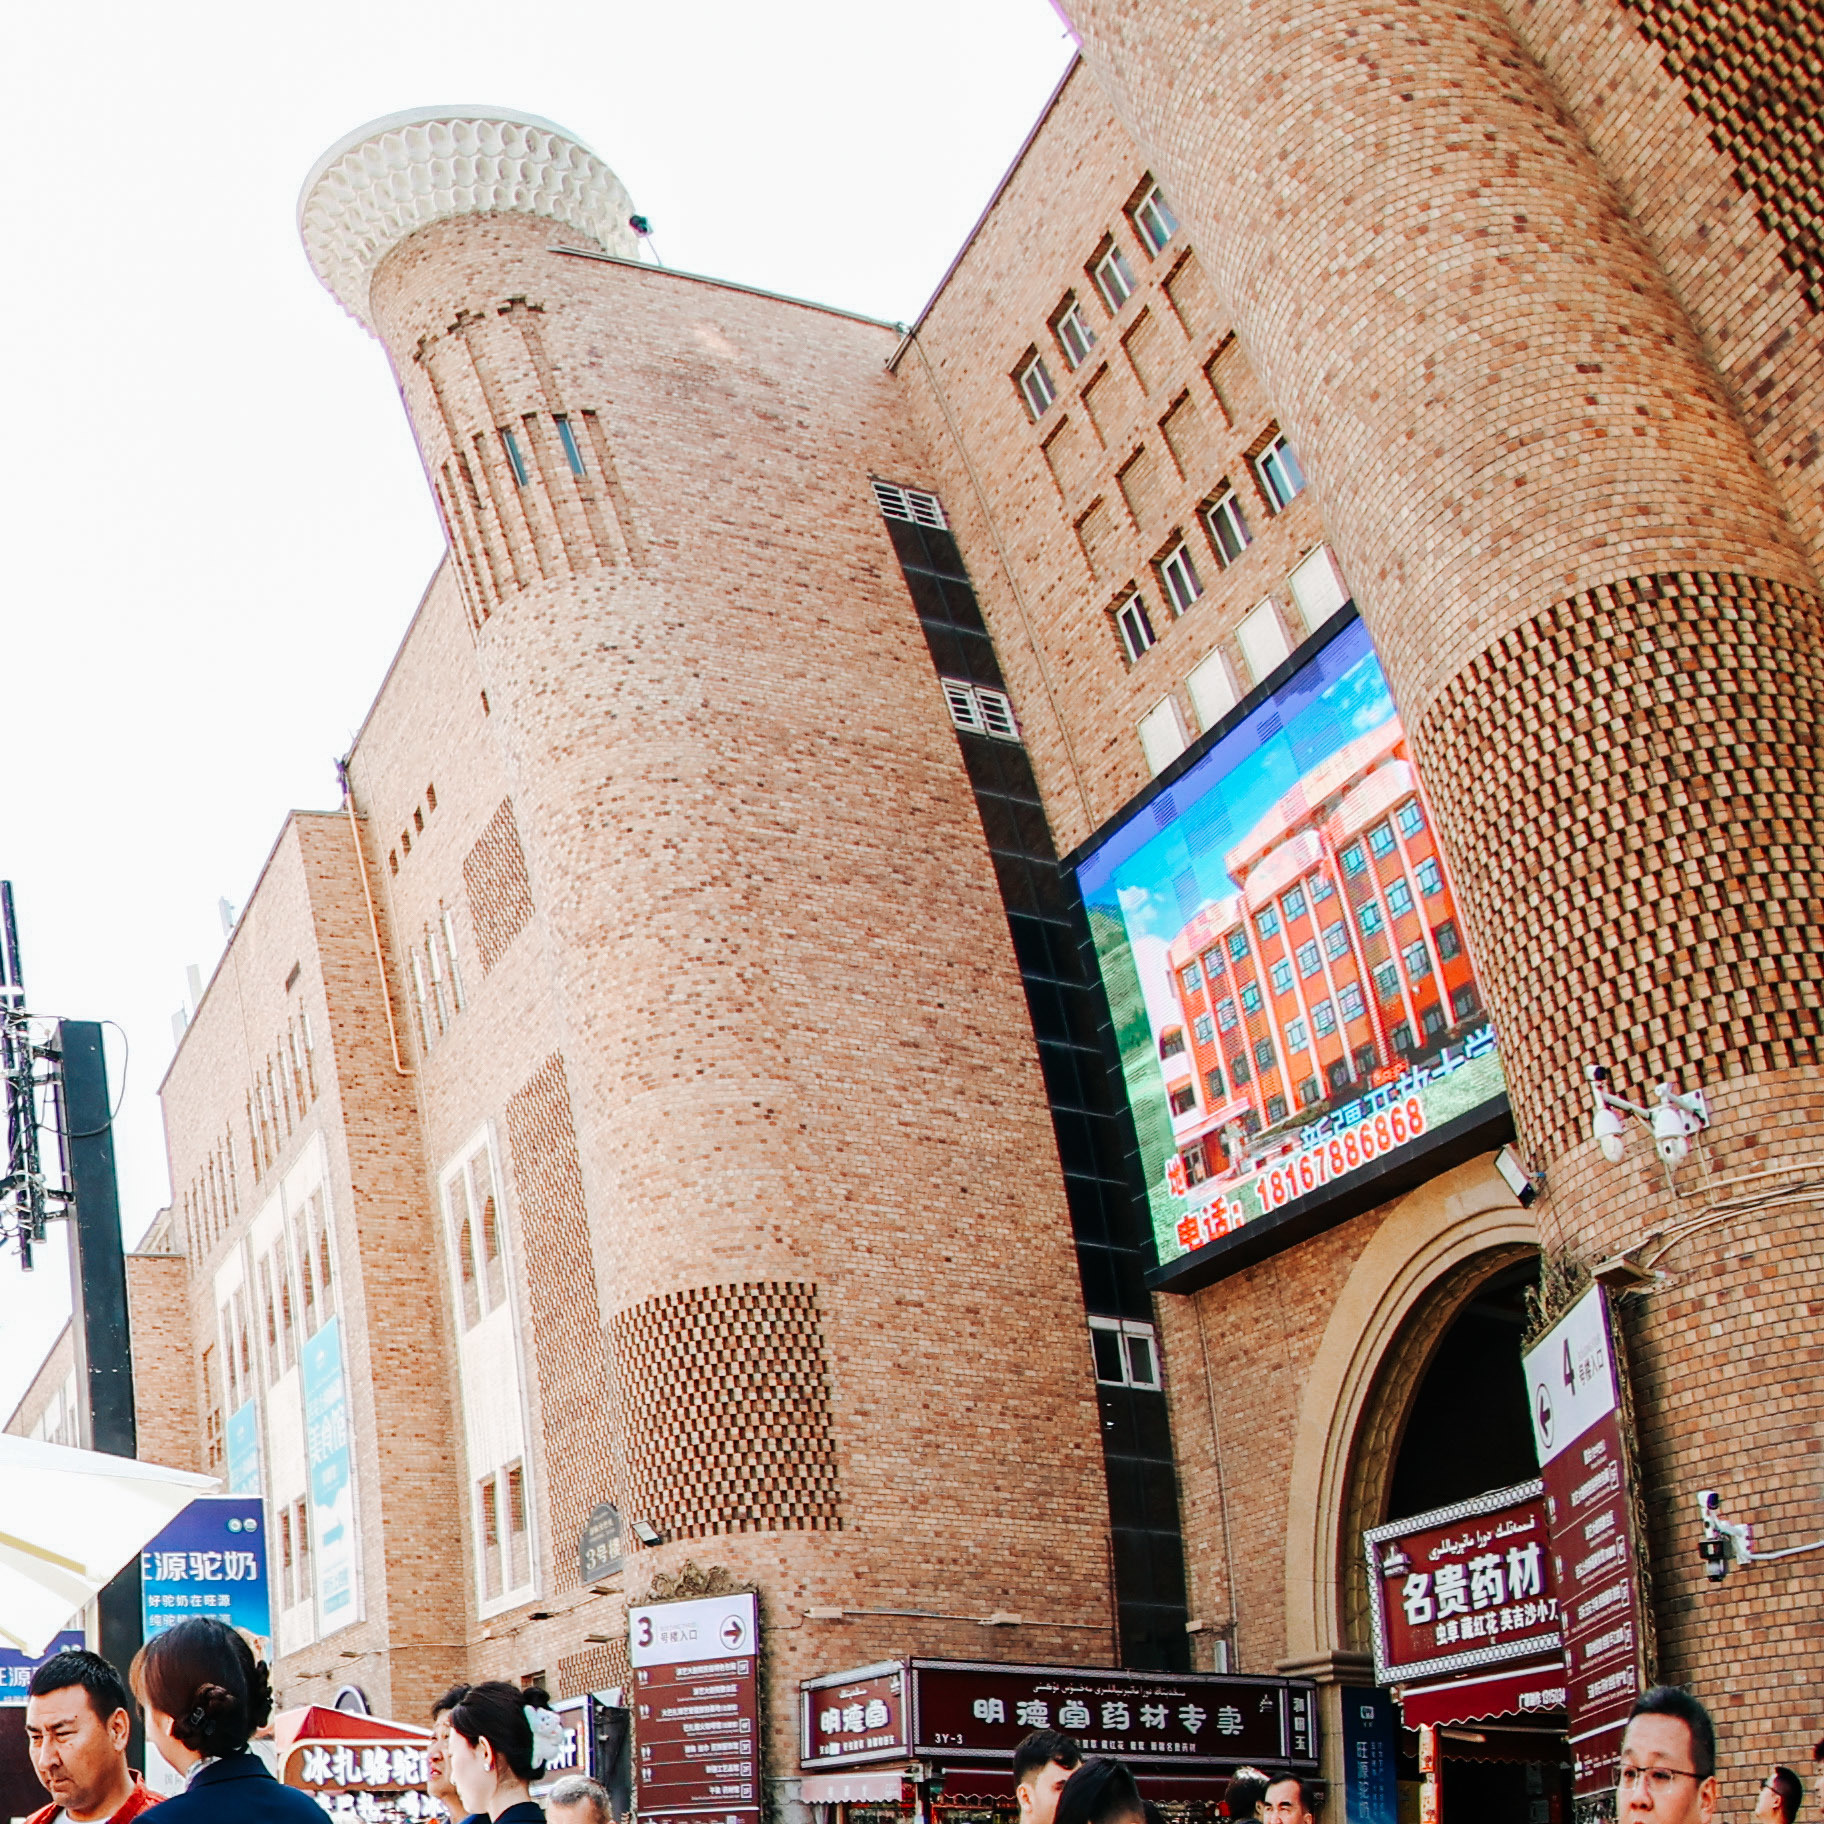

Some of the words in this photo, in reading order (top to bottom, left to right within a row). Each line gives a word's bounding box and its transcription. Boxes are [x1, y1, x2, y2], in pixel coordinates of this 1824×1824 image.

[1256, 1096, 1426, 1214] 18167886868
[1563, 1338, 1576, 1397] 4
[1403, 1542, 1542, 1625] 名贵药材
[638, 1616, 653, 1648] 3
[660, 1629, 698, 1644] 号楼入口
[820, 1699, 889, 1735] 明德堂
[973, 1697, 1245, 1736] 明德堂药材专卖
[934, 1733, 964, 1745] 3Y-3
[302, 1746, 429, 1787] 冰扎骆驼
